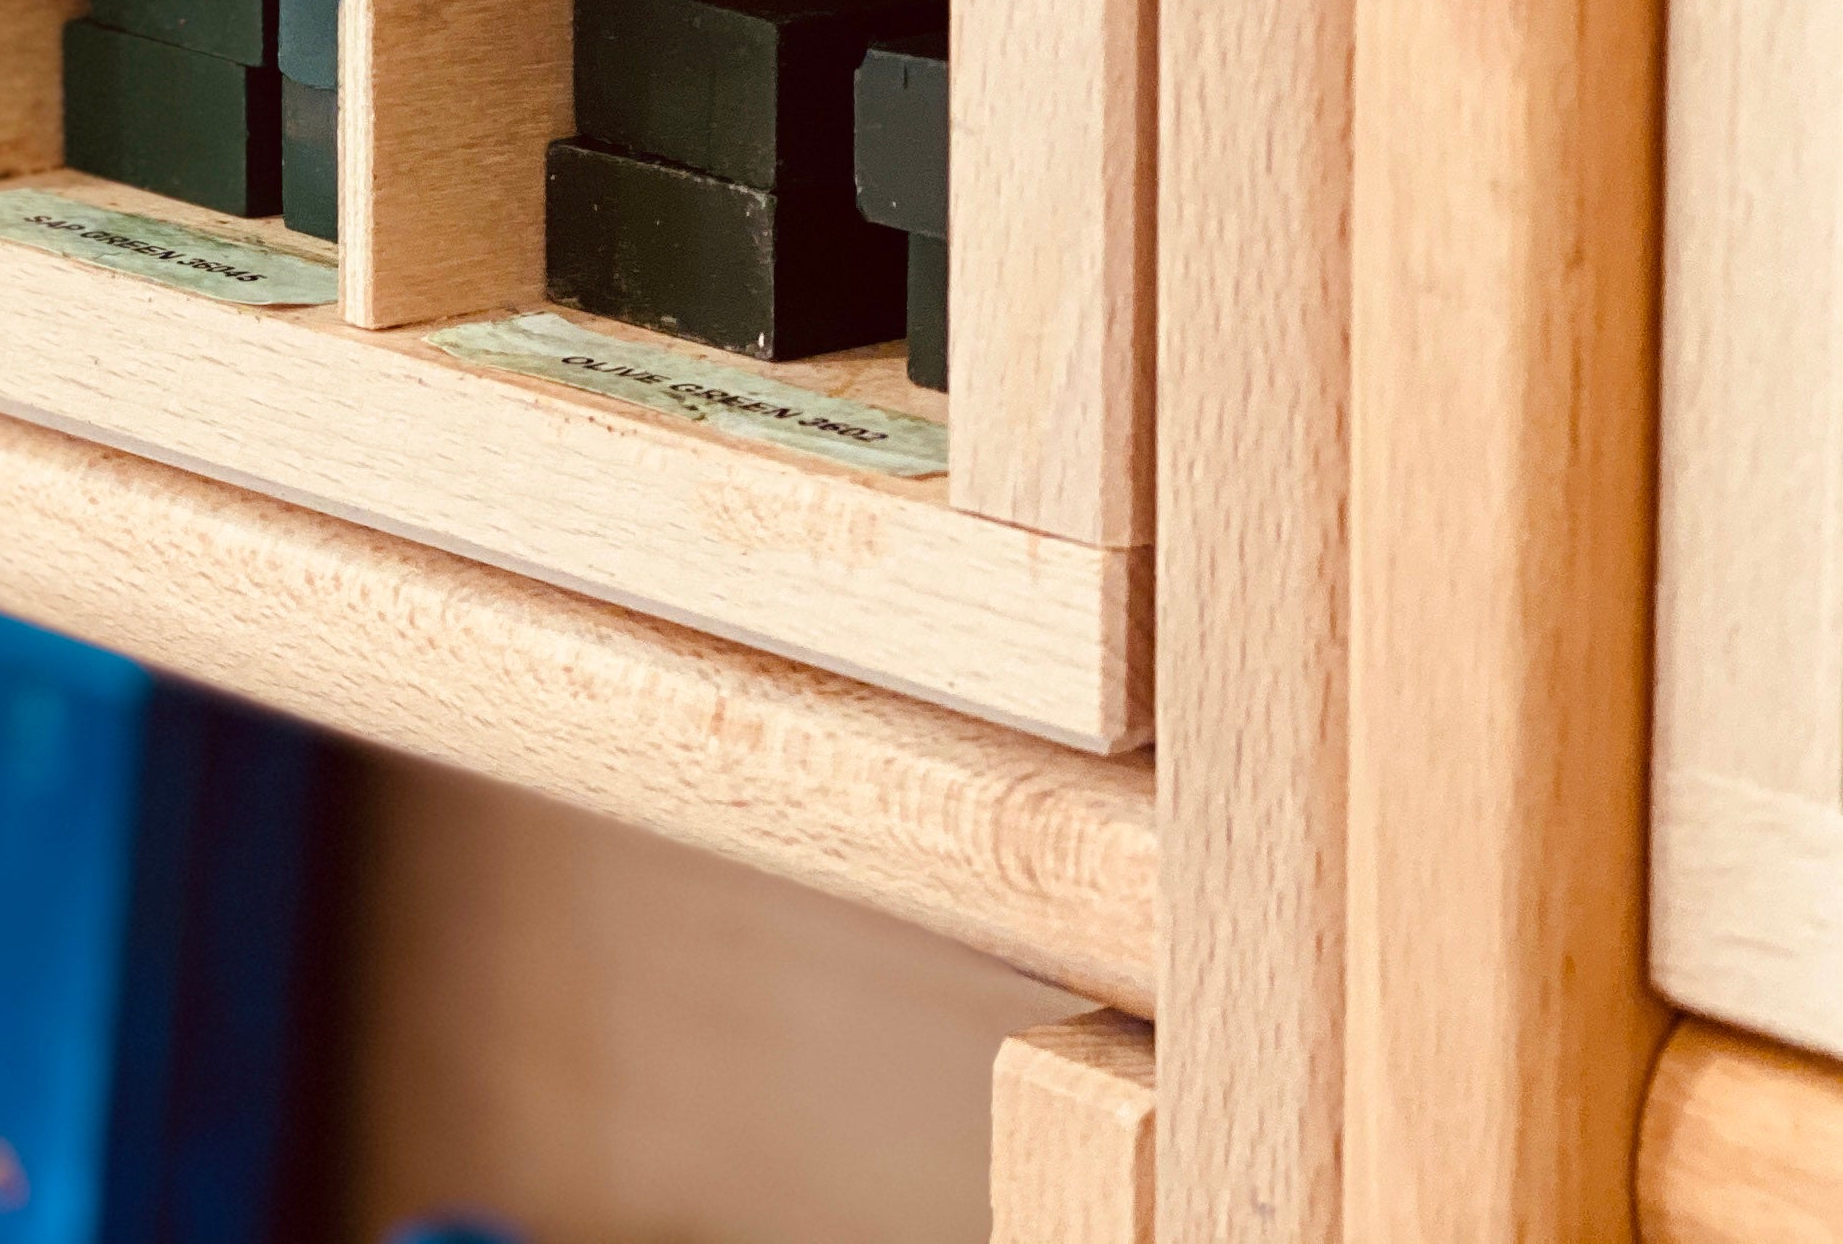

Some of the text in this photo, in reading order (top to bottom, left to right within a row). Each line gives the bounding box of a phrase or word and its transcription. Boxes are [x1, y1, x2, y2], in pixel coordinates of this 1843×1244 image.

[23, 215, 86, 230] SAP
[80, 231, 186, 260] GREEN
[561, 356, 890, 443] OLIVE GREEN 3602
